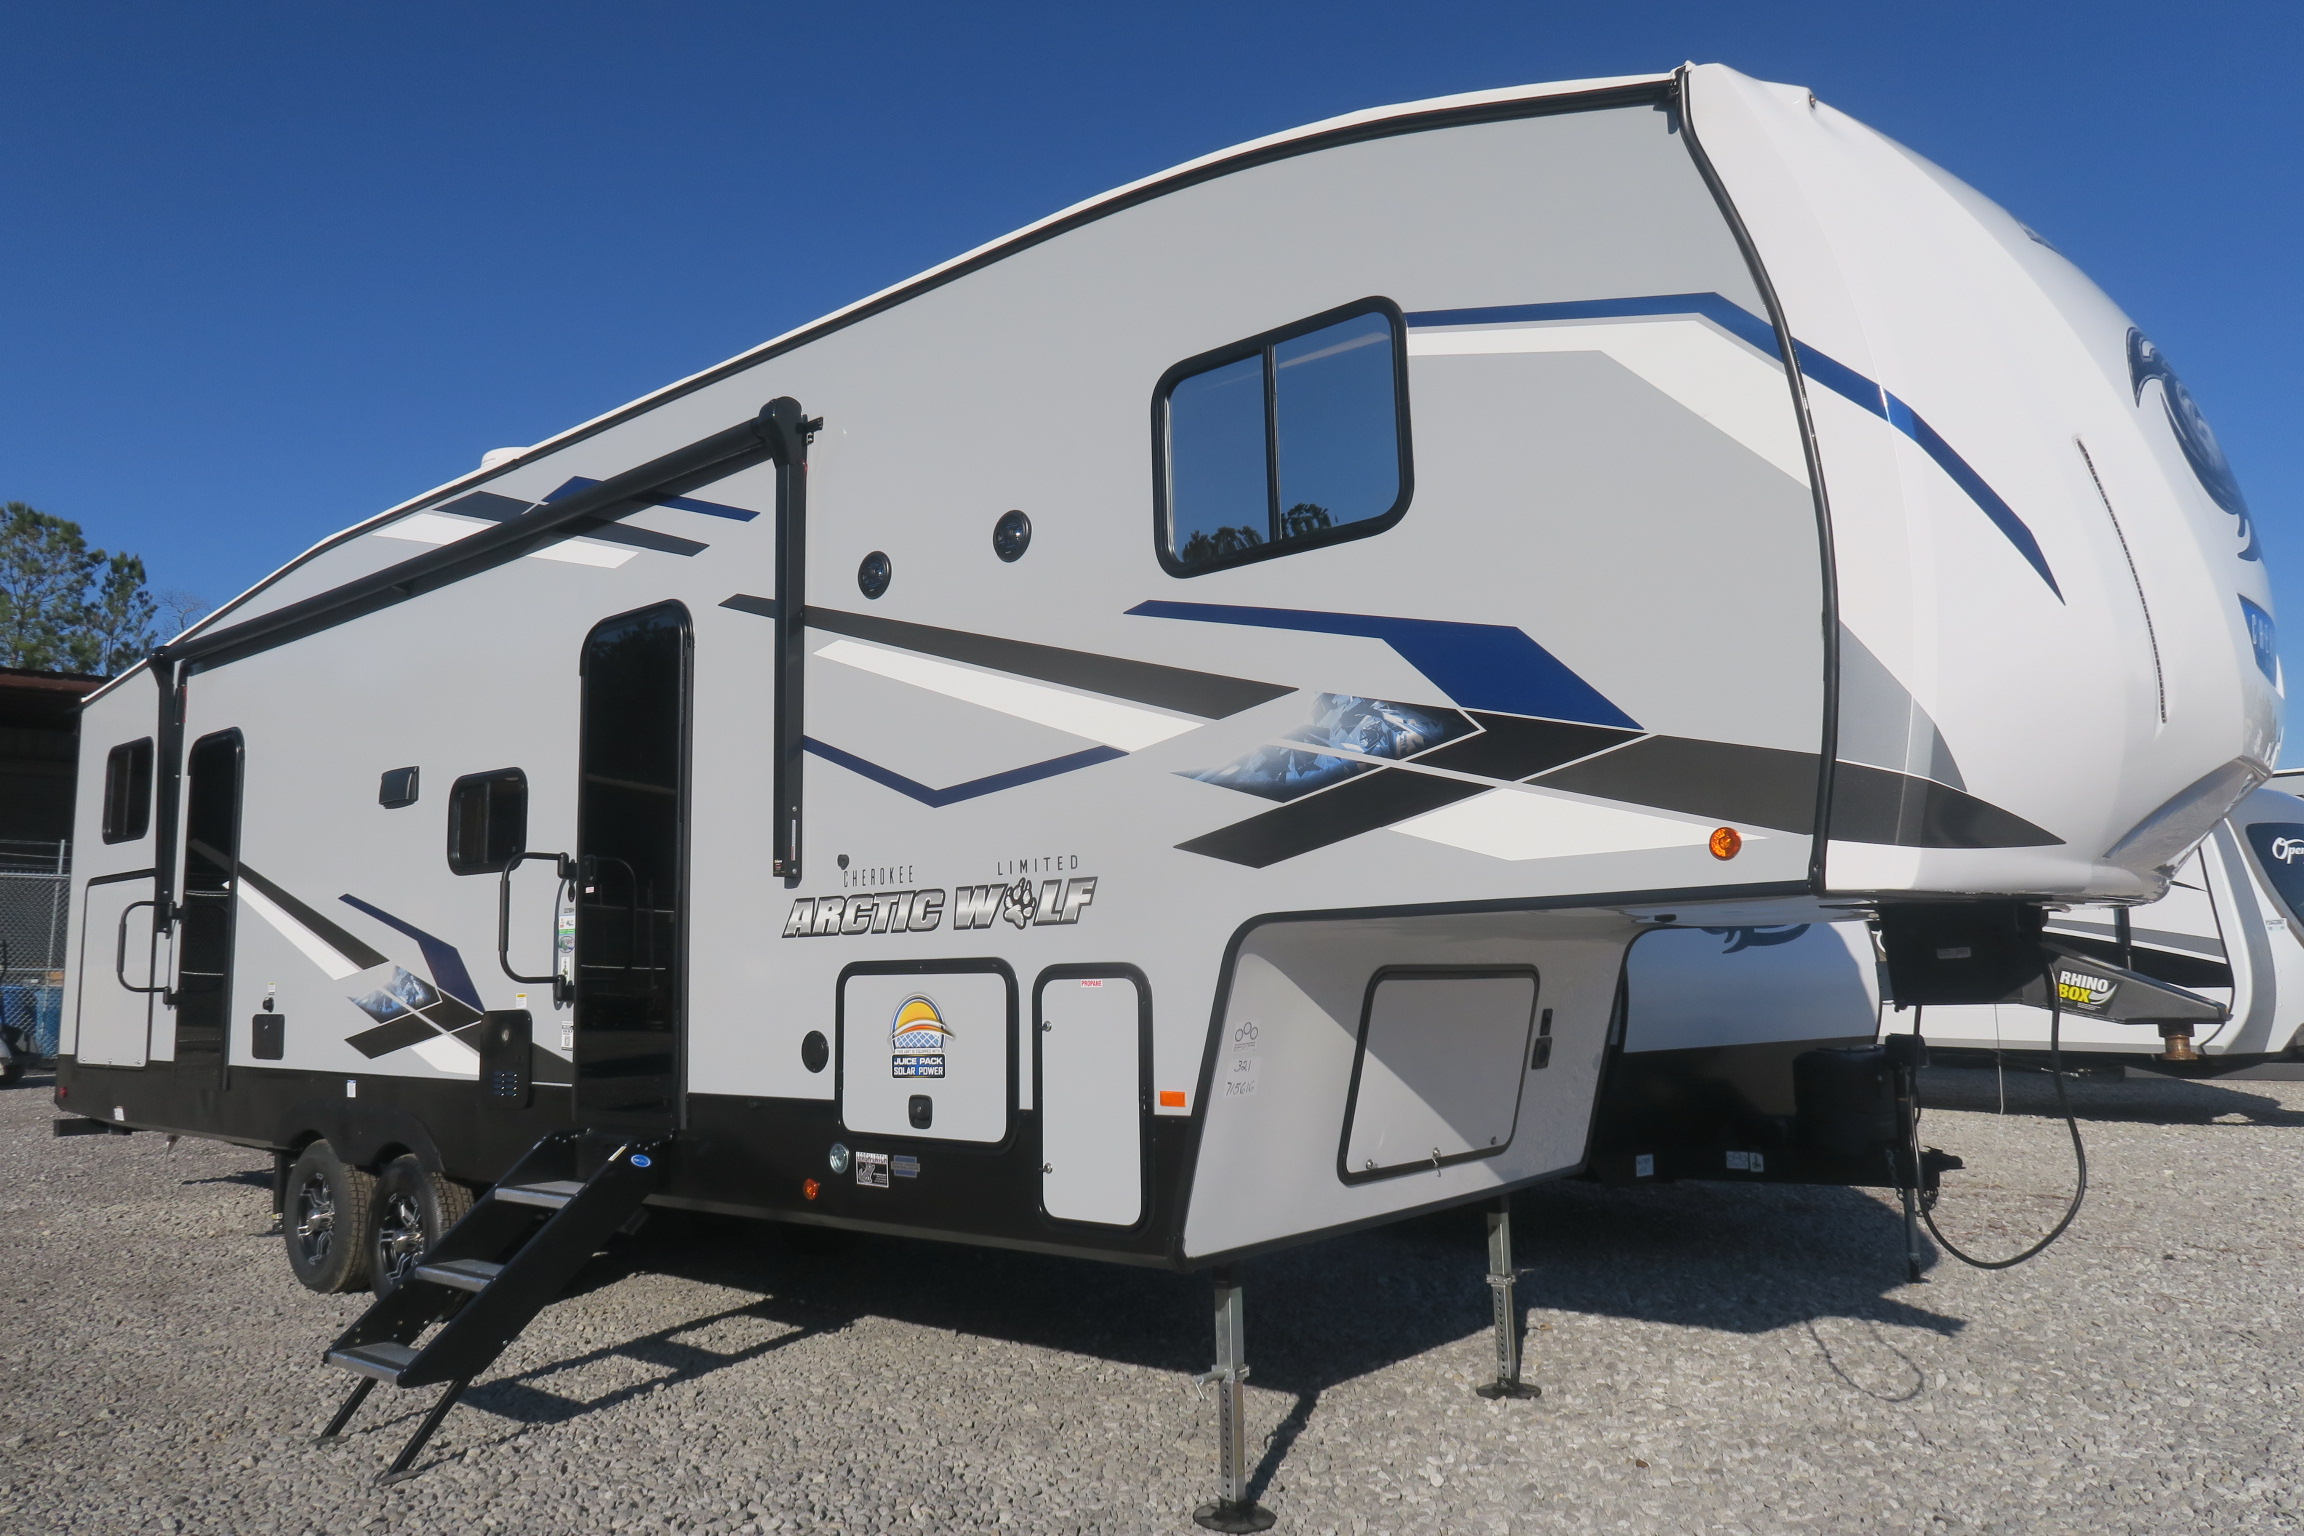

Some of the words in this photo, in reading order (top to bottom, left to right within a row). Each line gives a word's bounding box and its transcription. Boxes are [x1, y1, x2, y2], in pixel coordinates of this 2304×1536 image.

[843, 865, 914, 888] CHEROKEE
[997, 854, 1079, 876] LIMITED
[782, 888, 946, 938] ARCTIC
[2059, 970, 2109, 993] RHINO
[2058, 983, 2092, 1004] BOX
[893, 1057, 917, 1065] JUICE
[919, 1057, 943, 1065] PACK
[893, 1066, 916, 1075] SOLAR
[918, 1066, 944, 1075] POWER
[1233, 1060, 1252, 1073] 321
